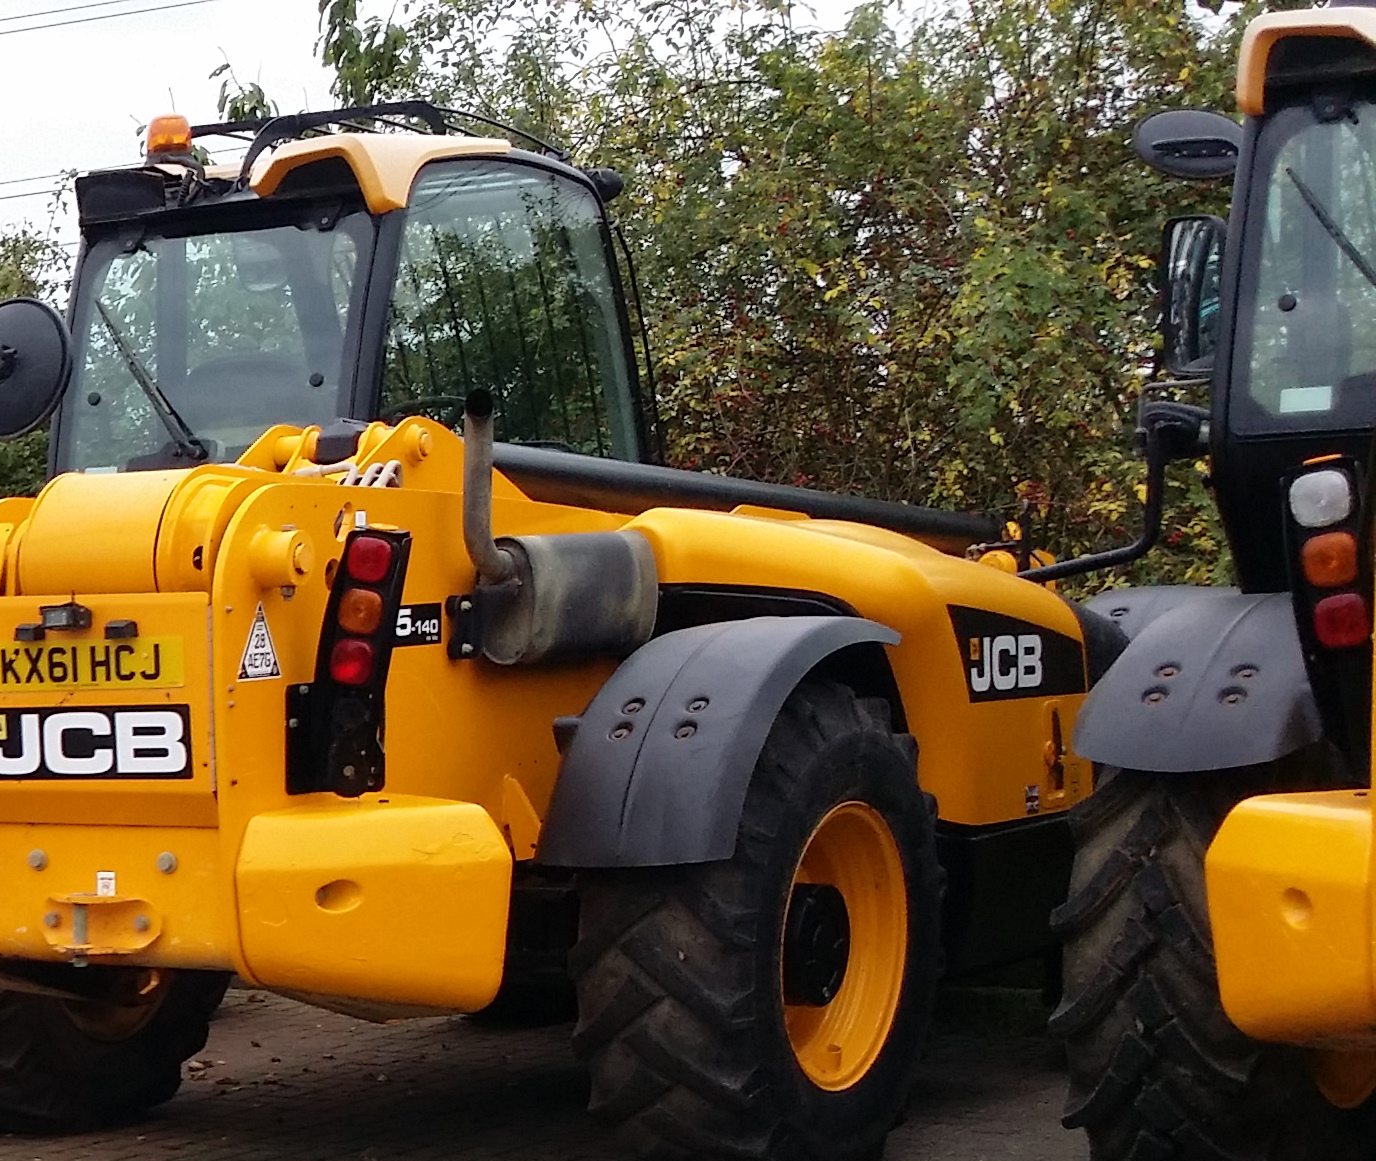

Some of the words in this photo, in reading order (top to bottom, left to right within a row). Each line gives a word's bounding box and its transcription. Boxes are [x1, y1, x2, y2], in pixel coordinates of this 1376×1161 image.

[254, 633, 266, 650] 28
[0, 646, 78, 684] KX61
[90, 643, 161, 682] HCJ
[969, 634, 1043, 692] JCB
